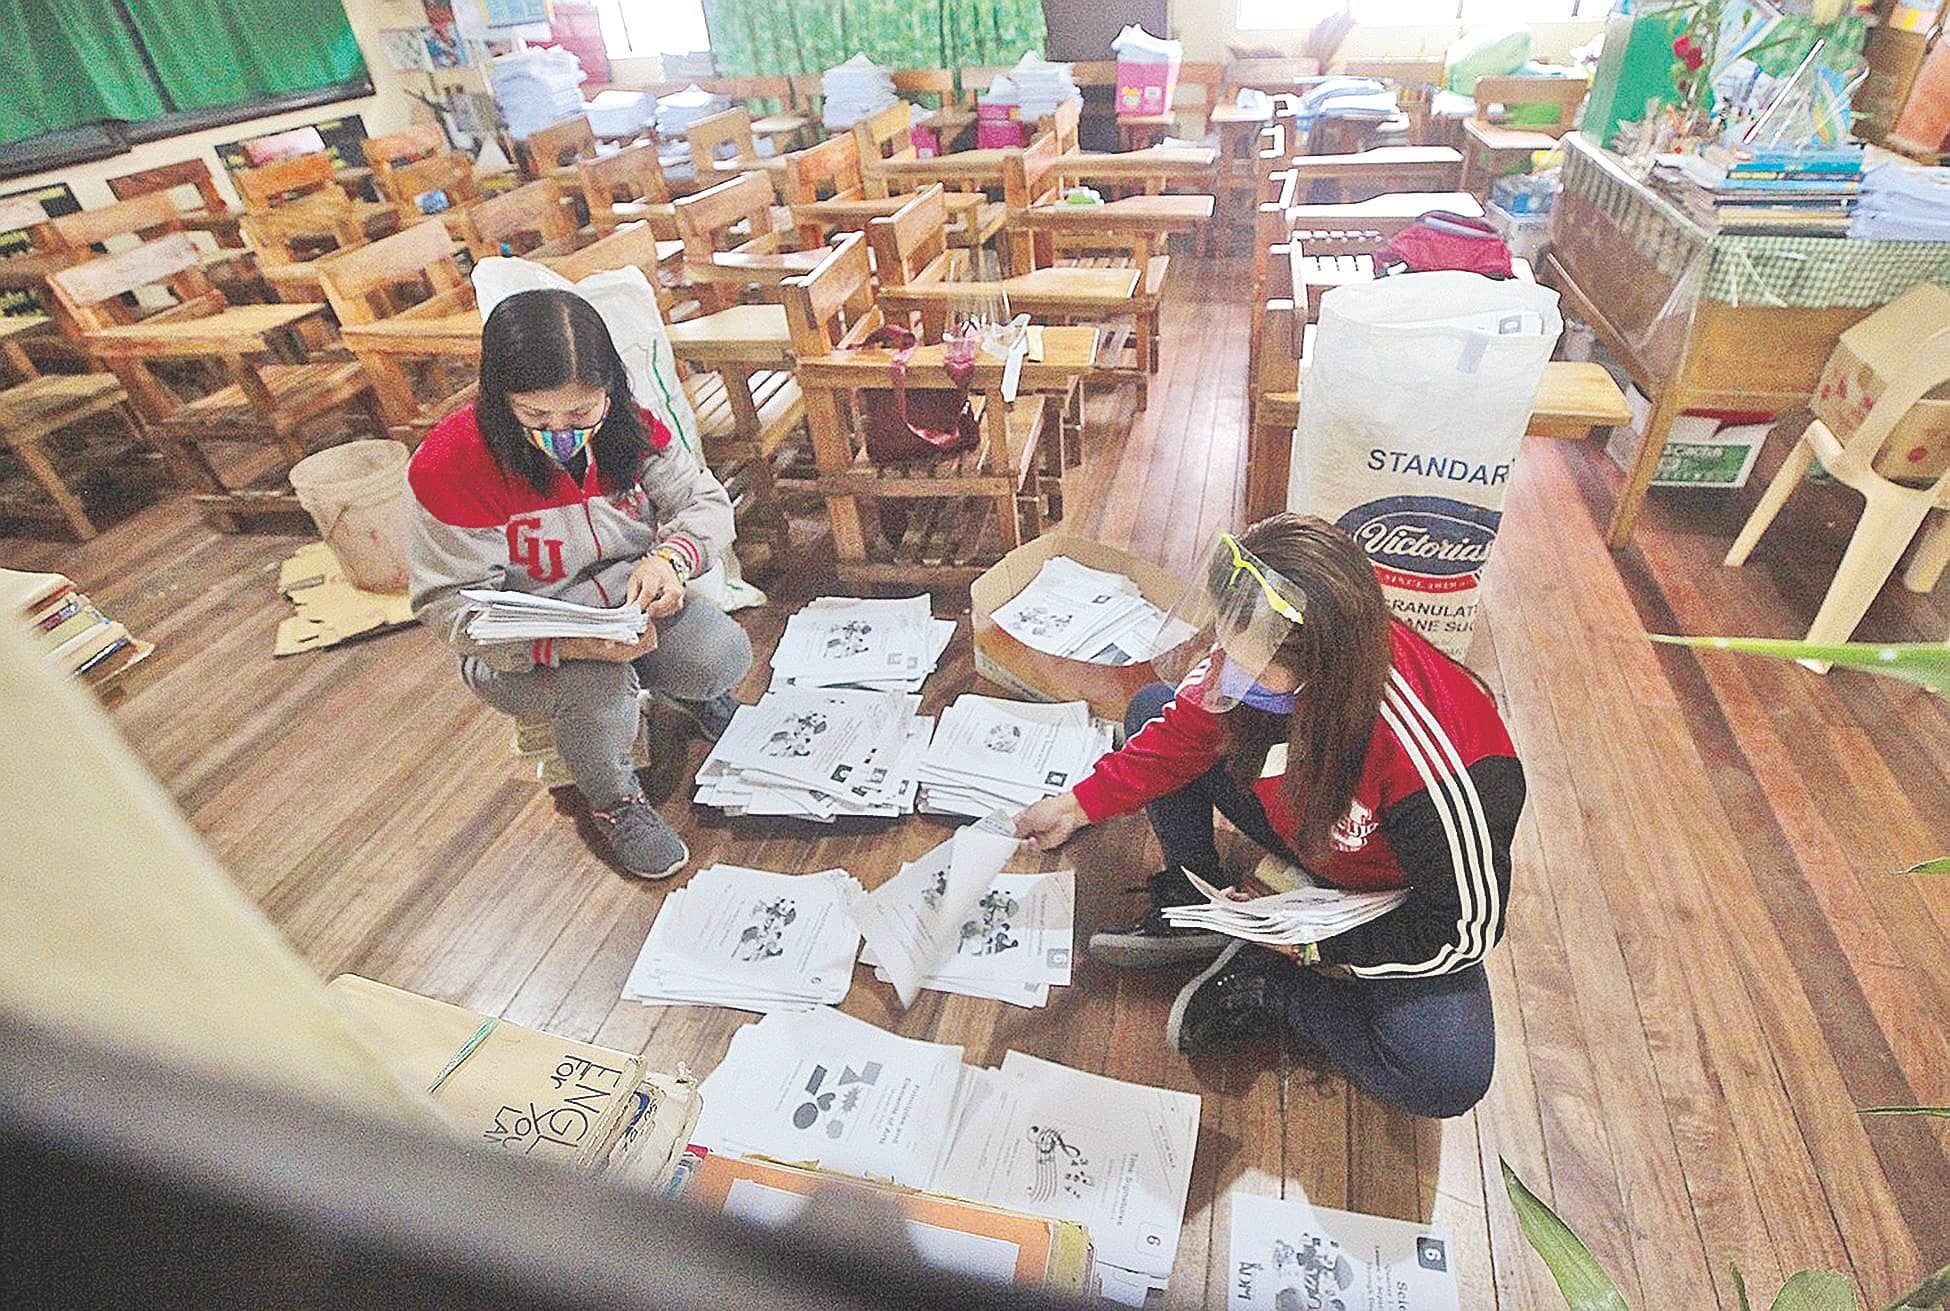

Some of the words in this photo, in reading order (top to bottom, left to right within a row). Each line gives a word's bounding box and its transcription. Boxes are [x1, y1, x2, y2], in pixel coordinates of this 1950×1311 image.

[1367, 448, 1511, 486] STANDAR
[506, 517, 568, 583] GU
[1361, 522, 1494, 562] Victorias
[1387, 599, 1477, 618] RANULAT
[525, 1063, 623, 1154] ENGL
[1146, 1235, 1161, 1246] 6
[1423, 1247, 1441, 1261] 6
[1397, 1281, 1408, 1311] Scie
